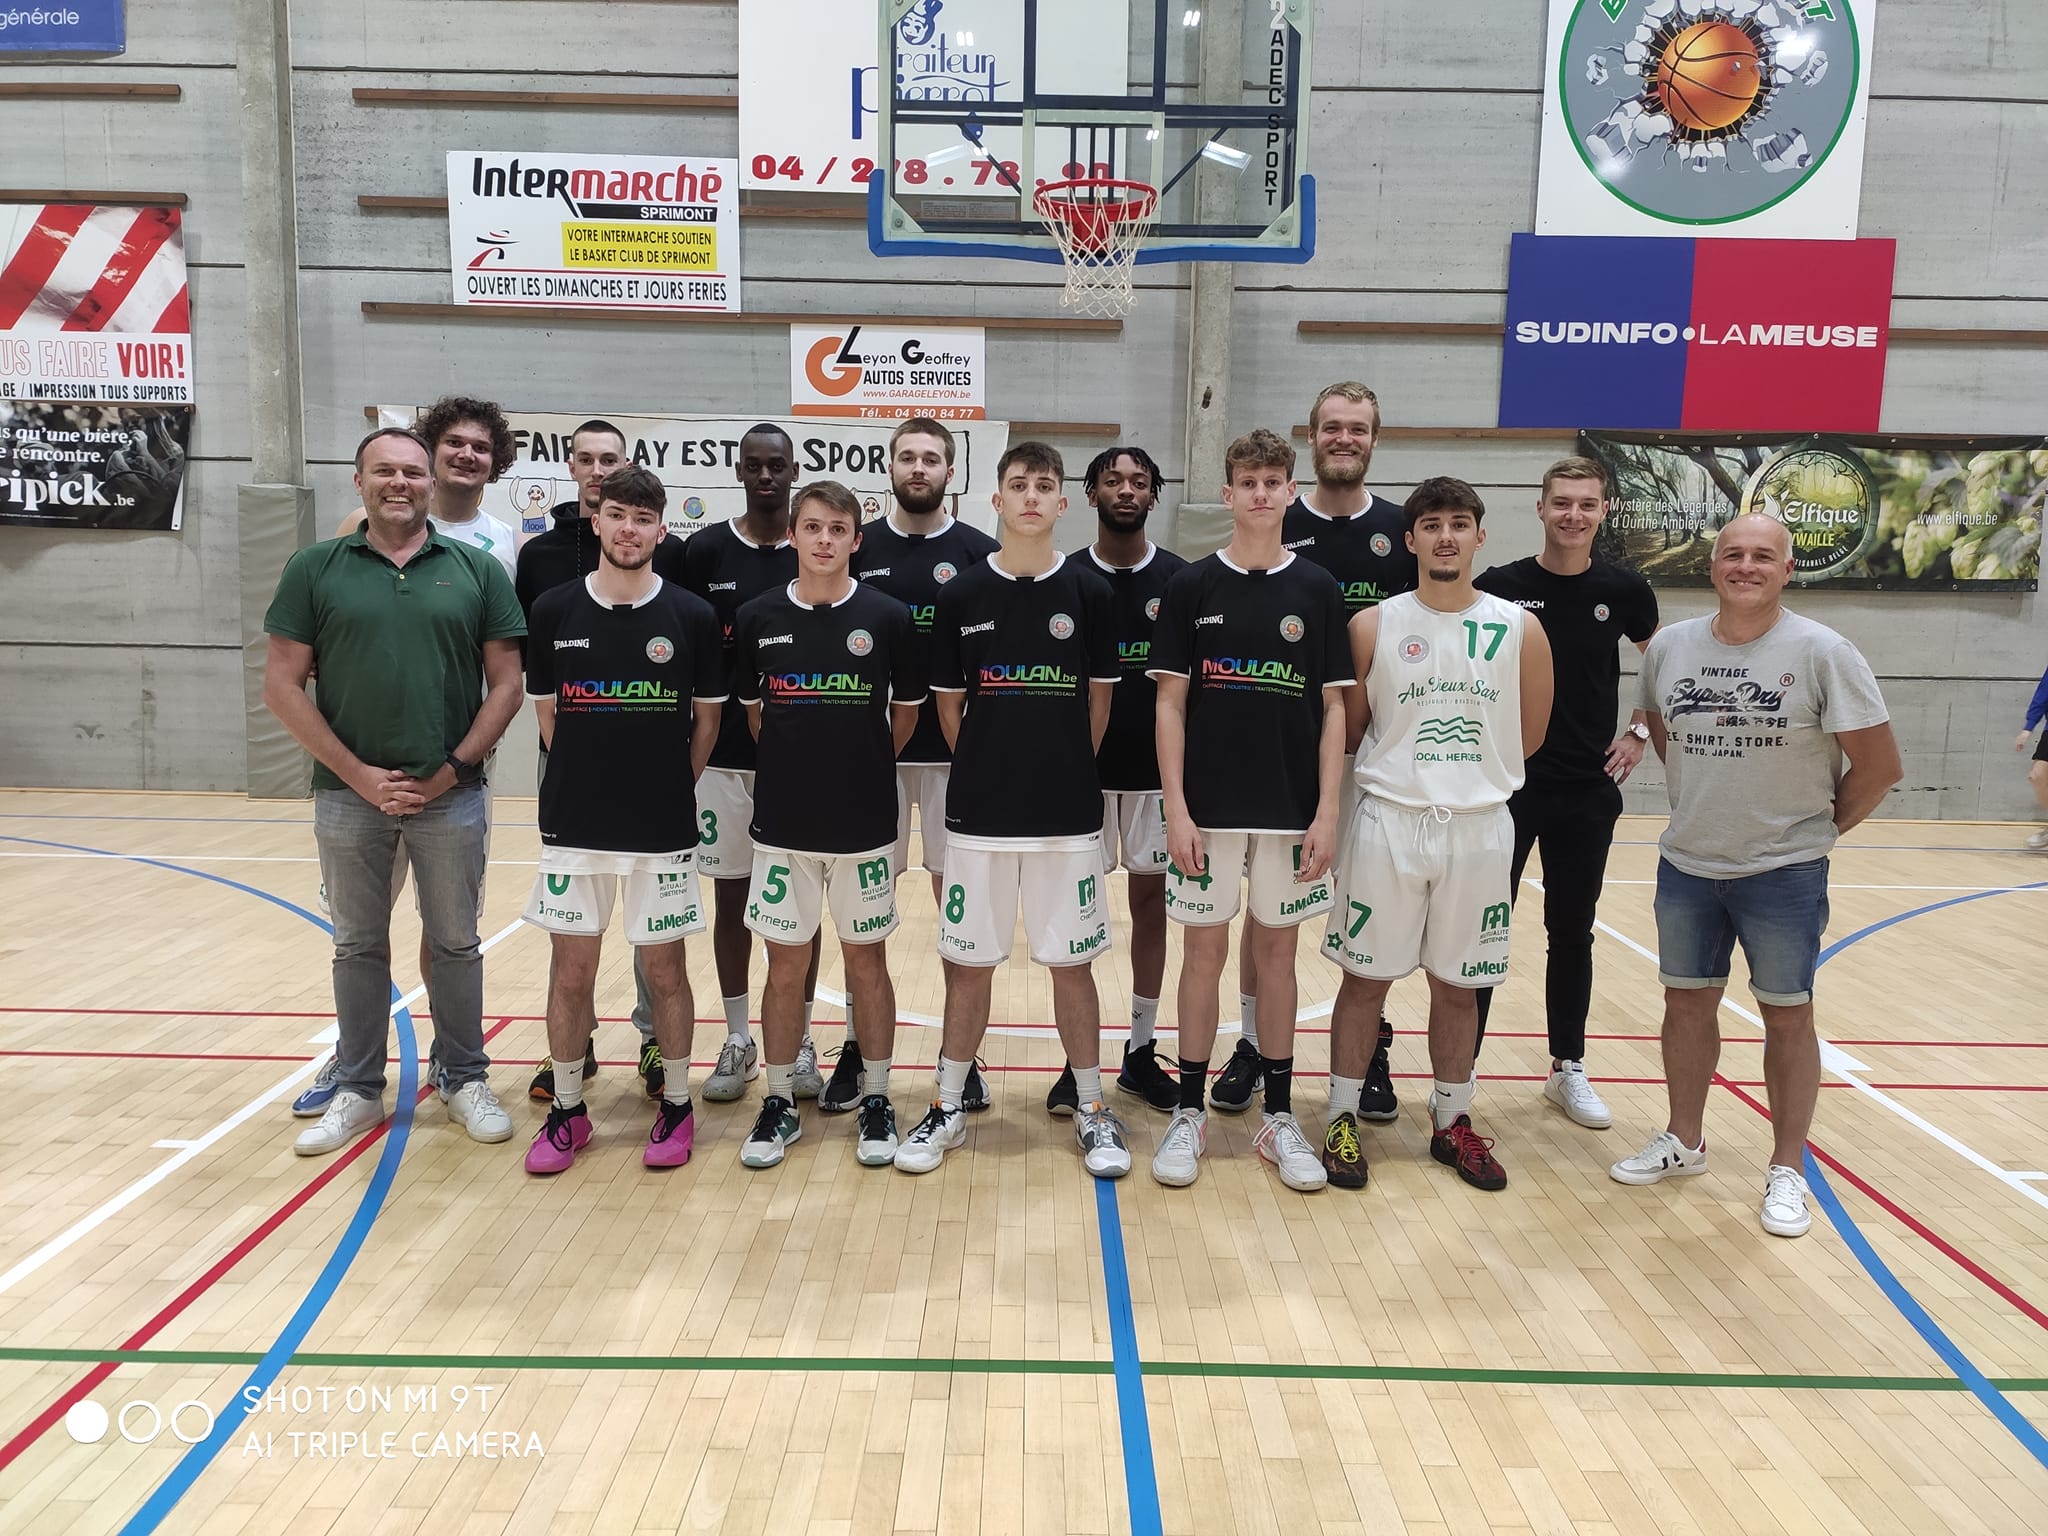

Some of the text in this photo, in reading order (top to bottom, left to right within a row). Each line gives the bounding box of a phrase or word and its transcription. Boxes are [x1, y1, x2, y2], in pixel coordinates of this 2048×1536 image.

[0, 8, 80, 30] générale
[897, 33, 996, 74] raiteur
[1268, 29, 1285, 105] ADEC
[1264, 113, 1281, 206] SPORT
[751, 154, 804, 182] 04
[851, 158, 928, 185] 28
[970, 160, 1021, 187] 78
[472, 157, 723, 218] Intermarché
[640, 207, 714, 222] SPRIMONT
[567, 229, 712, 246] VOTRE INTERMARCHE SOUTIEN
[570, 248, 711, 265] LE BASKET CLUB DE SPRIMONT
[467, 276, 728, 302] OUVERT LES DIMANCHES ET JOURS FERIES
[1516, 320, 1678, 345] SUDINFO
[38, 341, 109, 378] FAIRE
[117, 343, 185, 379] VOIR!
[901, 339, 971, 368] Geoffrey
[863, 370, 972, 387] AUTOS SERVICES
[30, 383, 97, 399] IMPRESSION
[100, 385, 129, 400] TOUS
[133, 385, 188, 401] SUPPORTS
[863, 389, 972, 400] www.GARAGELEYON.be
[895, 408, 910, 419] 04
[914, 408, 936, 419] 360
[940, 408, 956, 419] 84
[959, 408, 975, 419] 77
[84, 427, 133, 446] bière,
[12, 447, 106, 464] rencontre.
[628, 439, 670, 468] AY
[681, 439, 739, 468] EST
[803, 438, 888, 474] SPOR
[1610, 497, 1652, 514] Mystère
[1655, 498, 1673, 513] des
[1783, 500, 1859, 528] Elfique
[1612, 514, 1706, 531] d'Ourthe Amblève
[1917, 510, 1998, 529] www.elfique.be
[1792, 532, 1835, 547] YWAILLE
[758, 634, 793, 649] SPALDING
[1463, 619, 1509, 662] 17
[1701, 666, 1750, 678] VINTAGE
[1398, 682, 1427, 704] Au
[1667, 732, 1789, 748] EE. SHIRT. STORE.
[1712, 749, 1746, 759] JAPAN.
[699, 809, 718, 846] 3
[698, 852, 720, 866] ega
[761, 865, 791, 905] 5
[945, 884, 966, 925] 8
[1177, 898, 1214, 914] mega
[545, 905, 583, 923] mega
[761, 913, 798, 931] mega
[945, 934, 976, 951] mega
[1461, 960, 1509, 977] LaMeus
